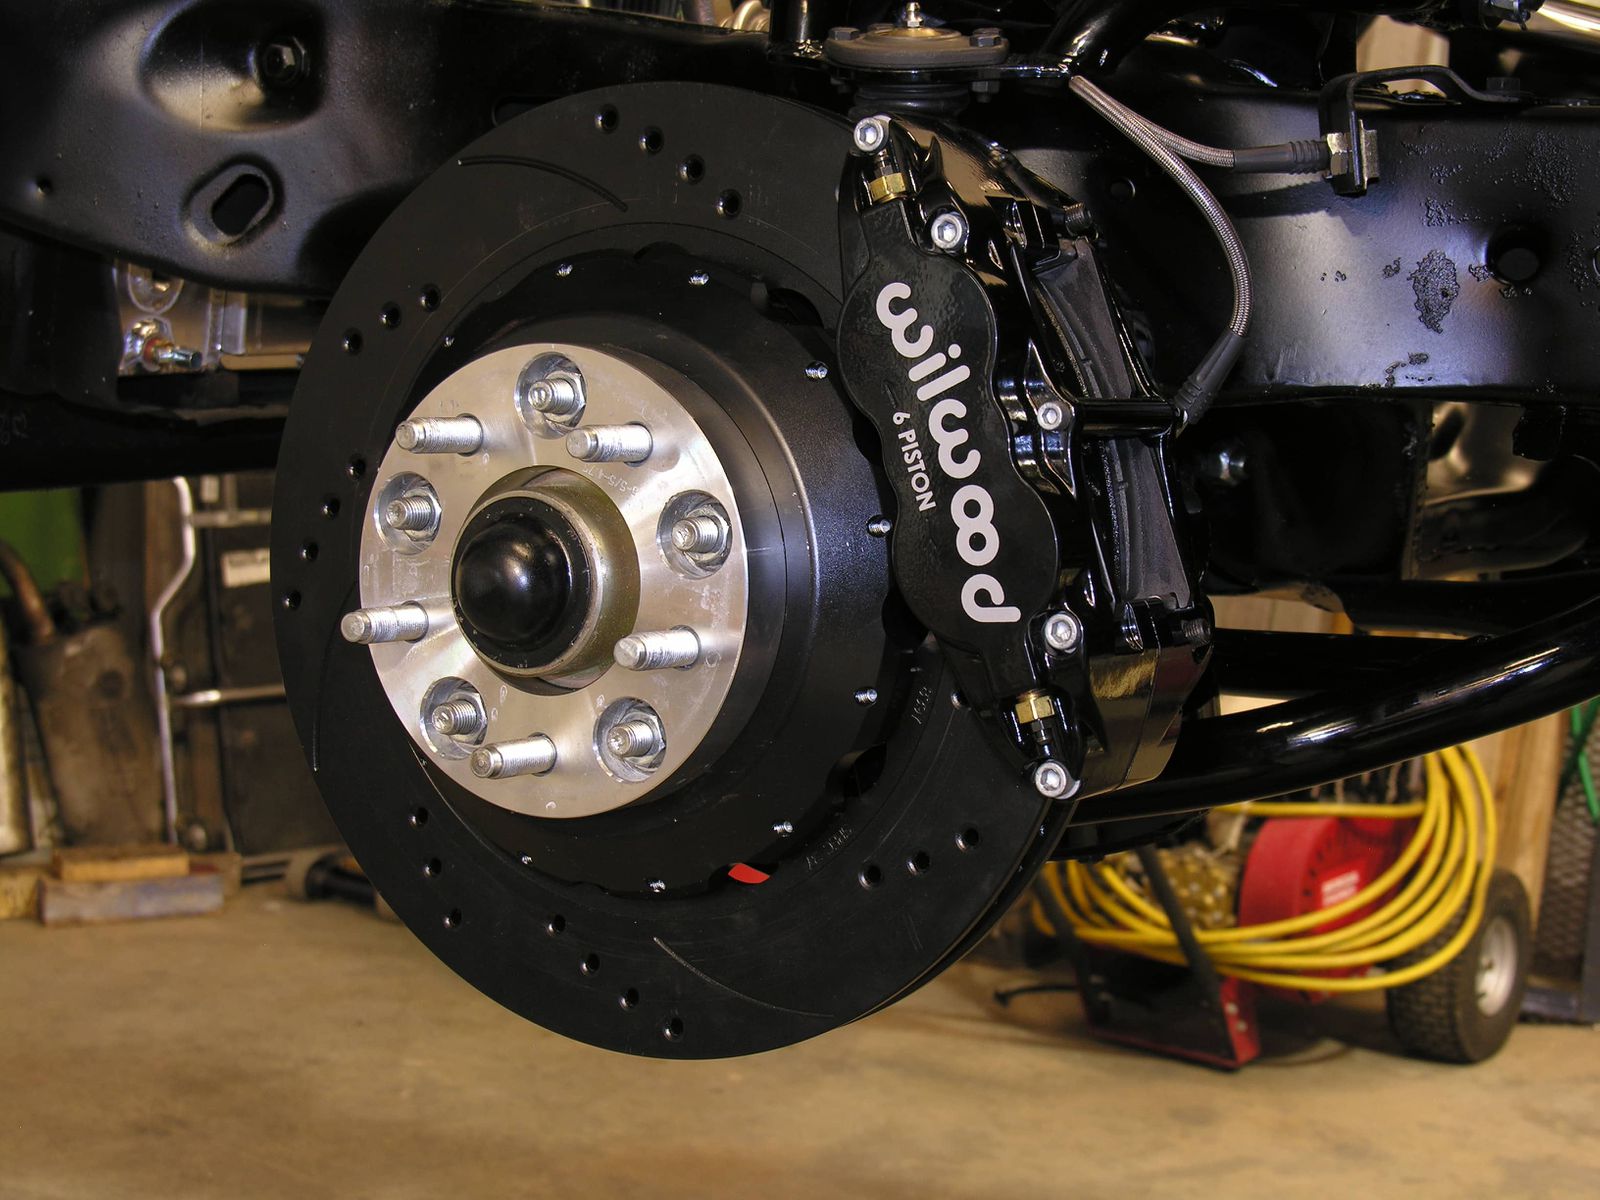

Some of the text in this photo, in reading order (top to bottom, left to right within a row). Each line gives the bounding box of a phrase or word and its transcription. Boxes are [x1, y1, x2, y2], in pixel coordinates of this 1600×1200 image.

[875, 281, 1022, 623] wilwood
[892, 411, 937, 512] 6 PISTON
